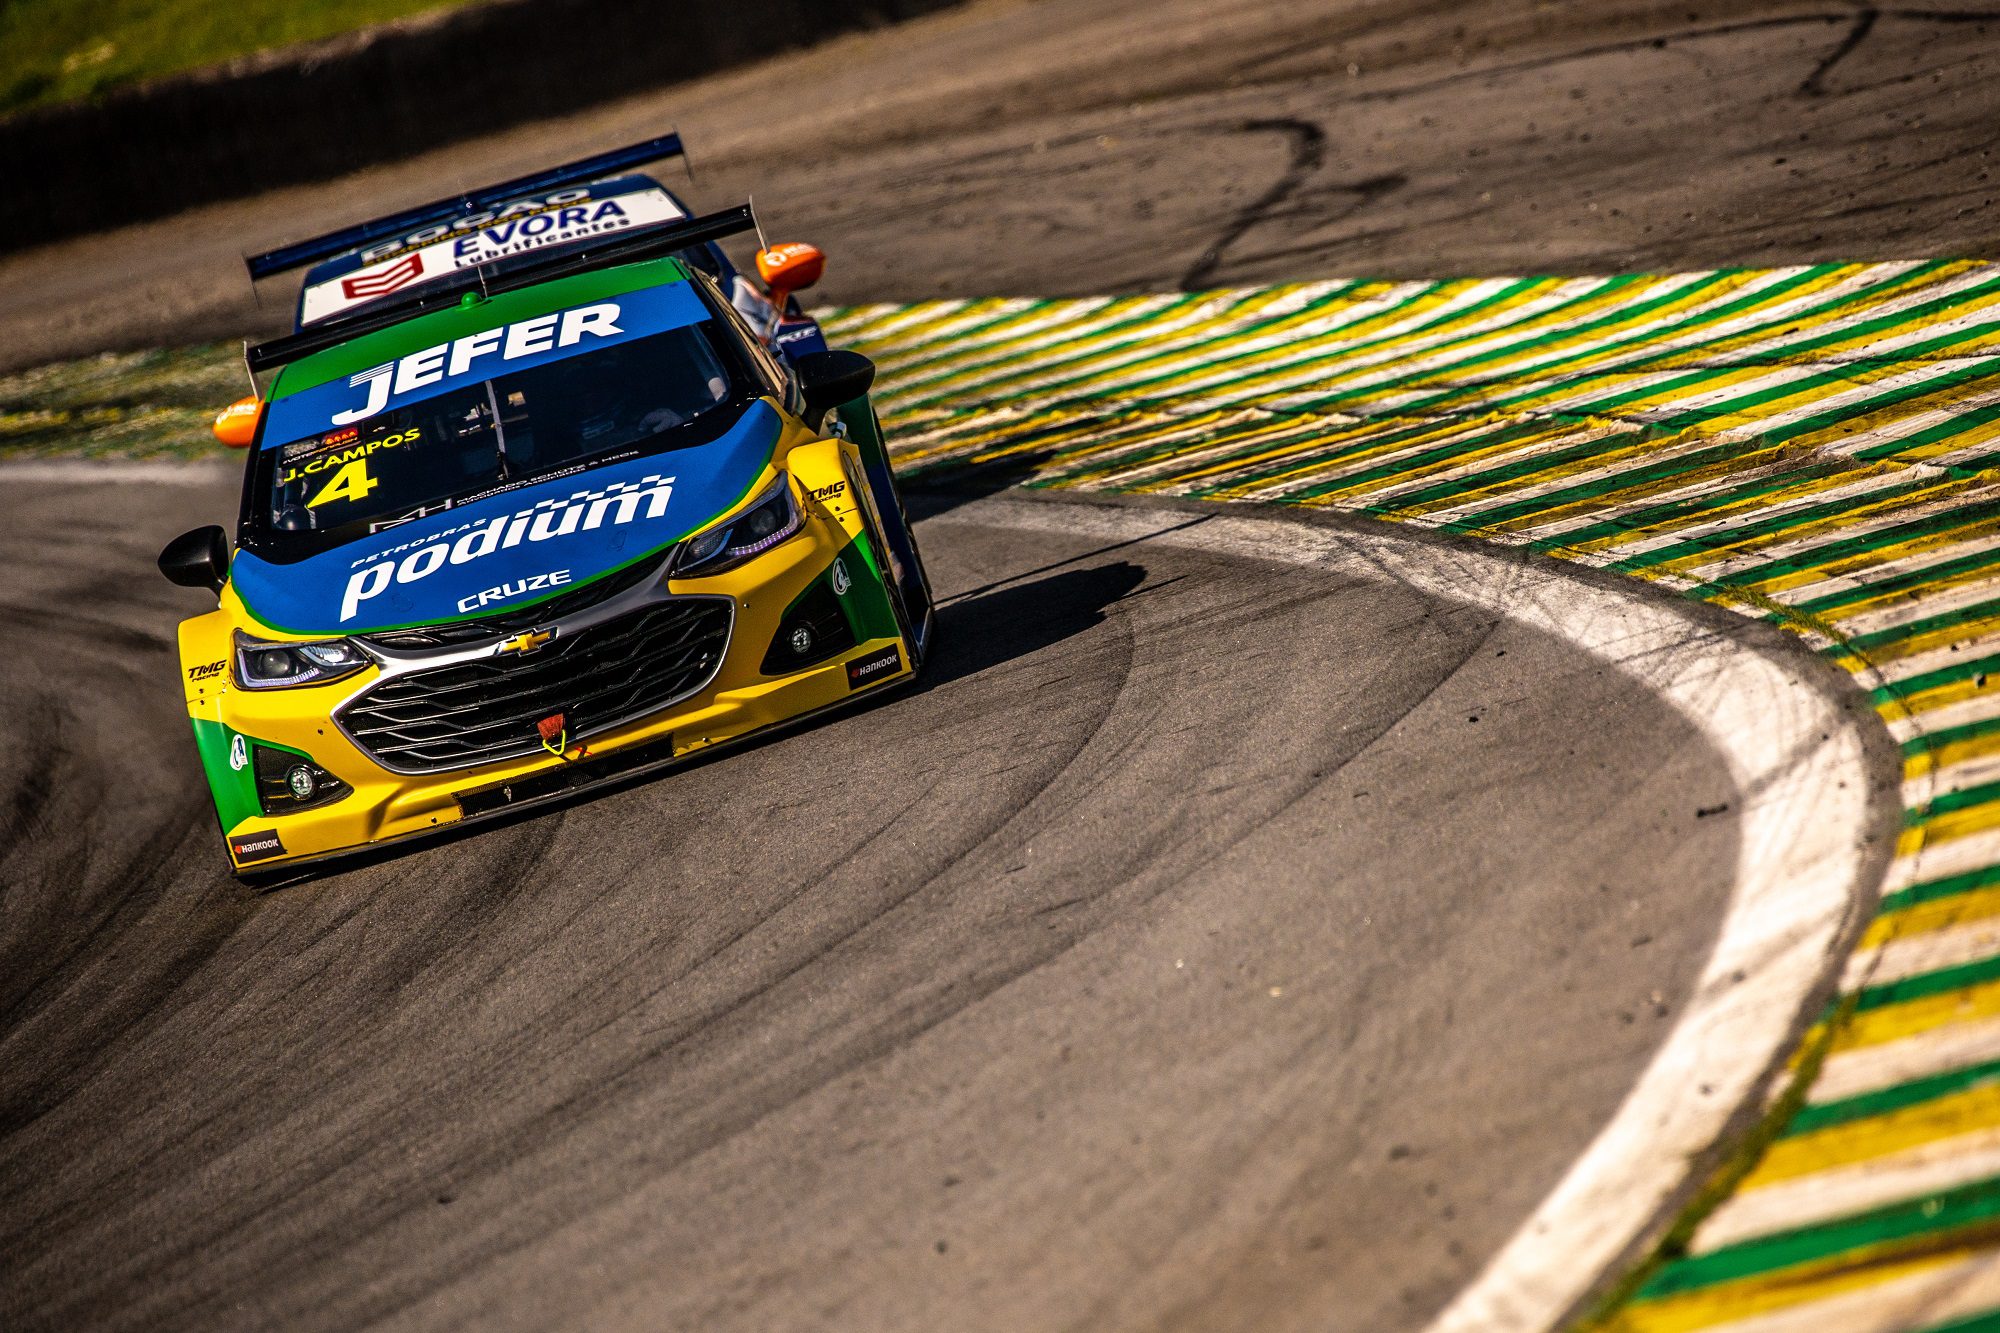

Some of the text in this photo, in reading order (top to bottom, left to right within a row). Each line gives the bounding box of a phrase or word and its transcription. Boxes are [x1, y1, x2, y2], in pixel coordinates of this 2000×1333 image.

[454, 200, 626, 258] EVORA
[454, 218, 630, 268] Lubrificantes
[332, 303, 624, 425] JEFER
[283, 428, 420, 482] J.CAMPOS
[307, 457, 378, 508] 4
[806, 480, 846, 499] TMG
[339, 475, 676, 622] podium
[351, 517, 487, 569] PETROBRAS
[457, 569, 572, 613] CRUZE
[188, 660, 227, 678] TMG
